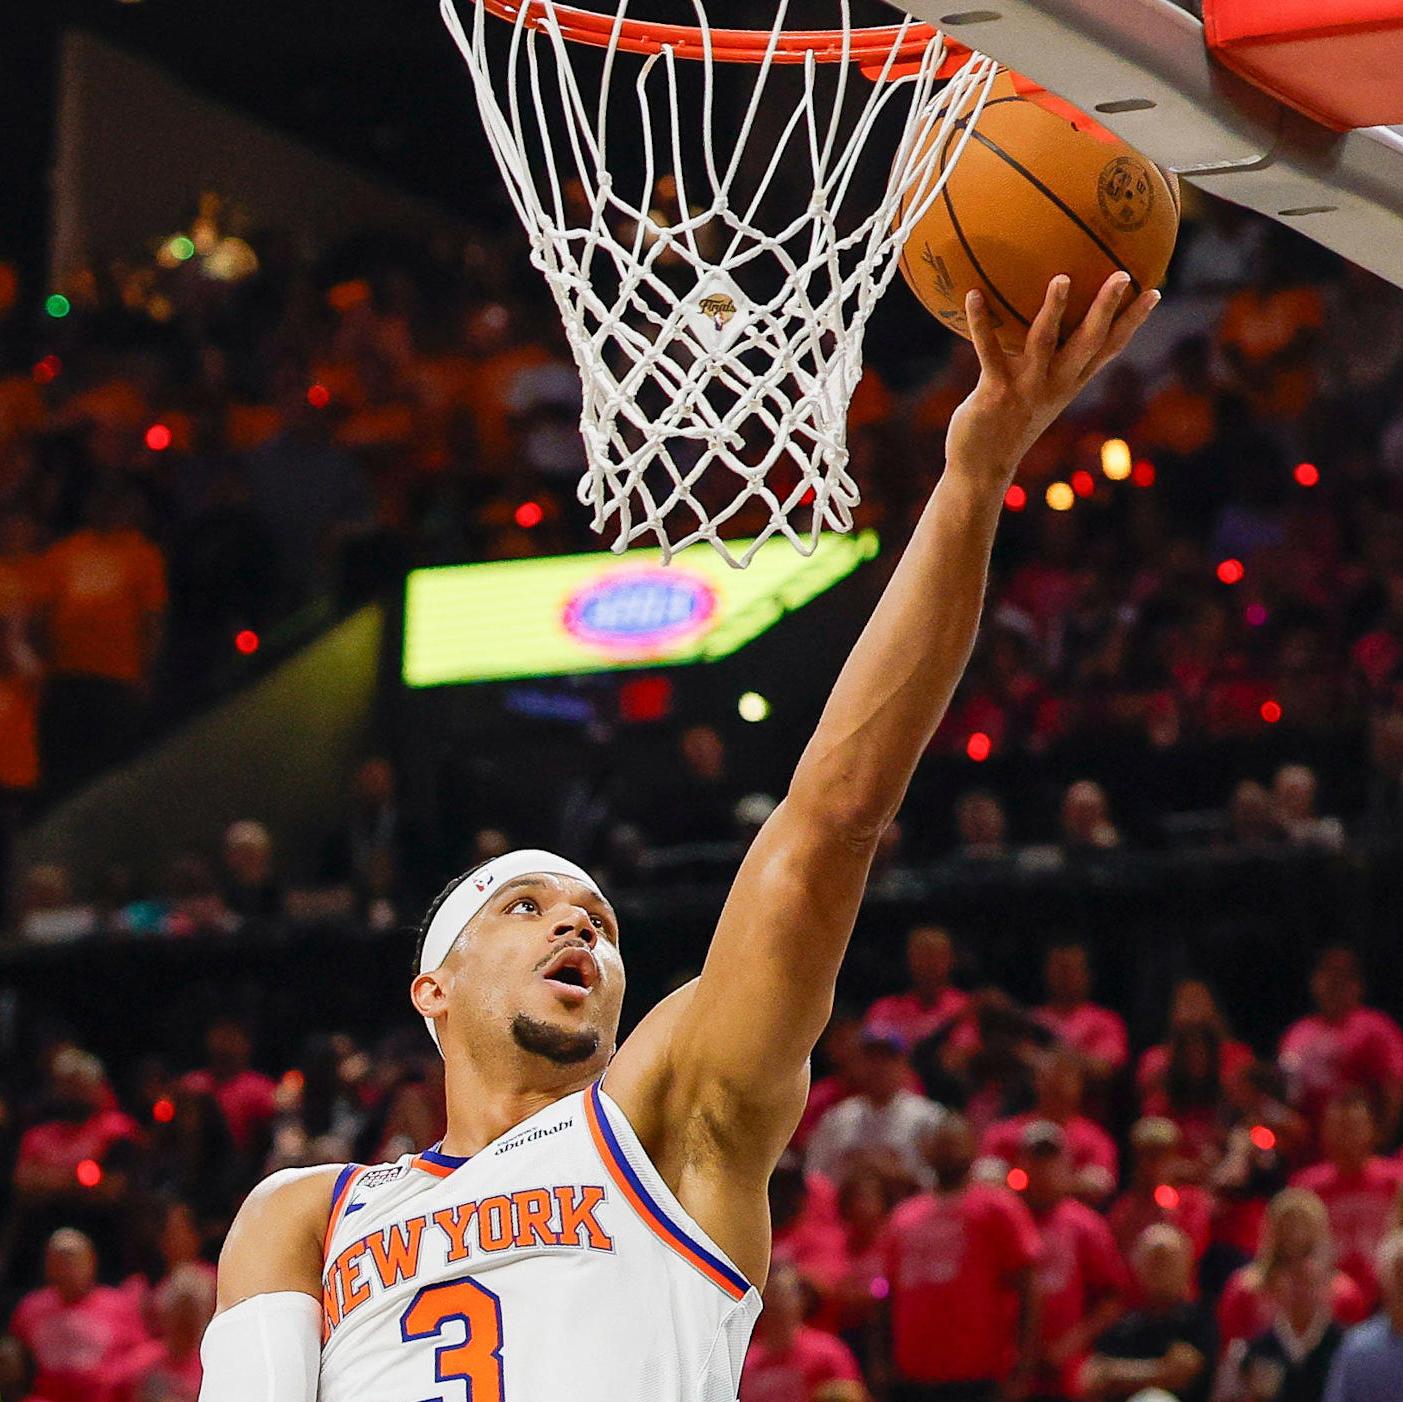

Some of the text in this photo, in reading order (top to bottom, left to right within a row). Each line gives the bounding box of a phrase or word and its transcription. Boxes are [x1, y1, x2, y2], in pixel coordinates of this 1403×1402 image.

[527, 1115, 574, 1142] dhabi
[322, 1185, 614, 1346] NEW YORK
